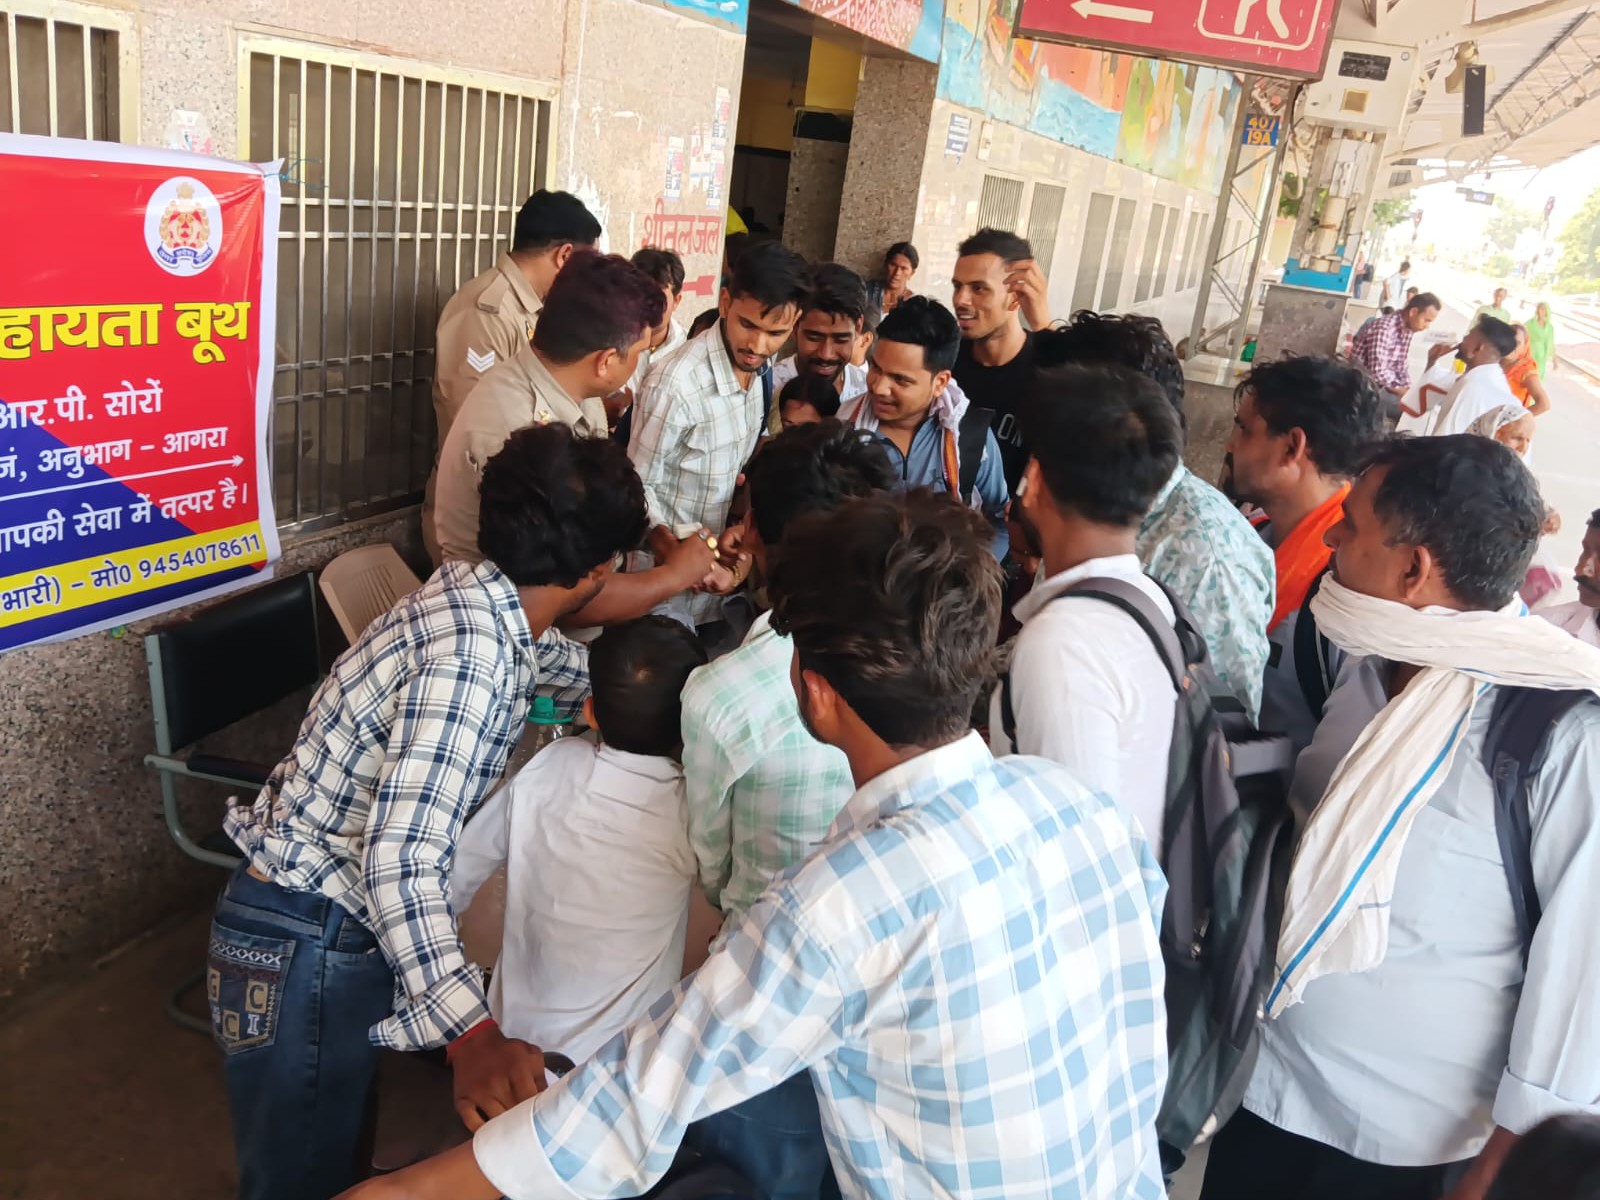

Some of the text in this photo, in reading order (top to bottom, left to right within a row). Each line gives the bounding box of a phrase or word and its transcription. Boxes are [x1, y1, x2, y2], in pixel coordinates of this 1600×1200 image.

[174, 301, 252, 364] बूथ
[103, 378, 164, 418] सोरों
[37, 438, 133, 479] अनुभाग
[162, 426, 229, 454] आगरा
[72, 502, 123, 537] सेवा
[128, 492, 153, 524] में
[158, 489, 217, 519] तत्पर
[138, 533, 261, 579] 9454078611
